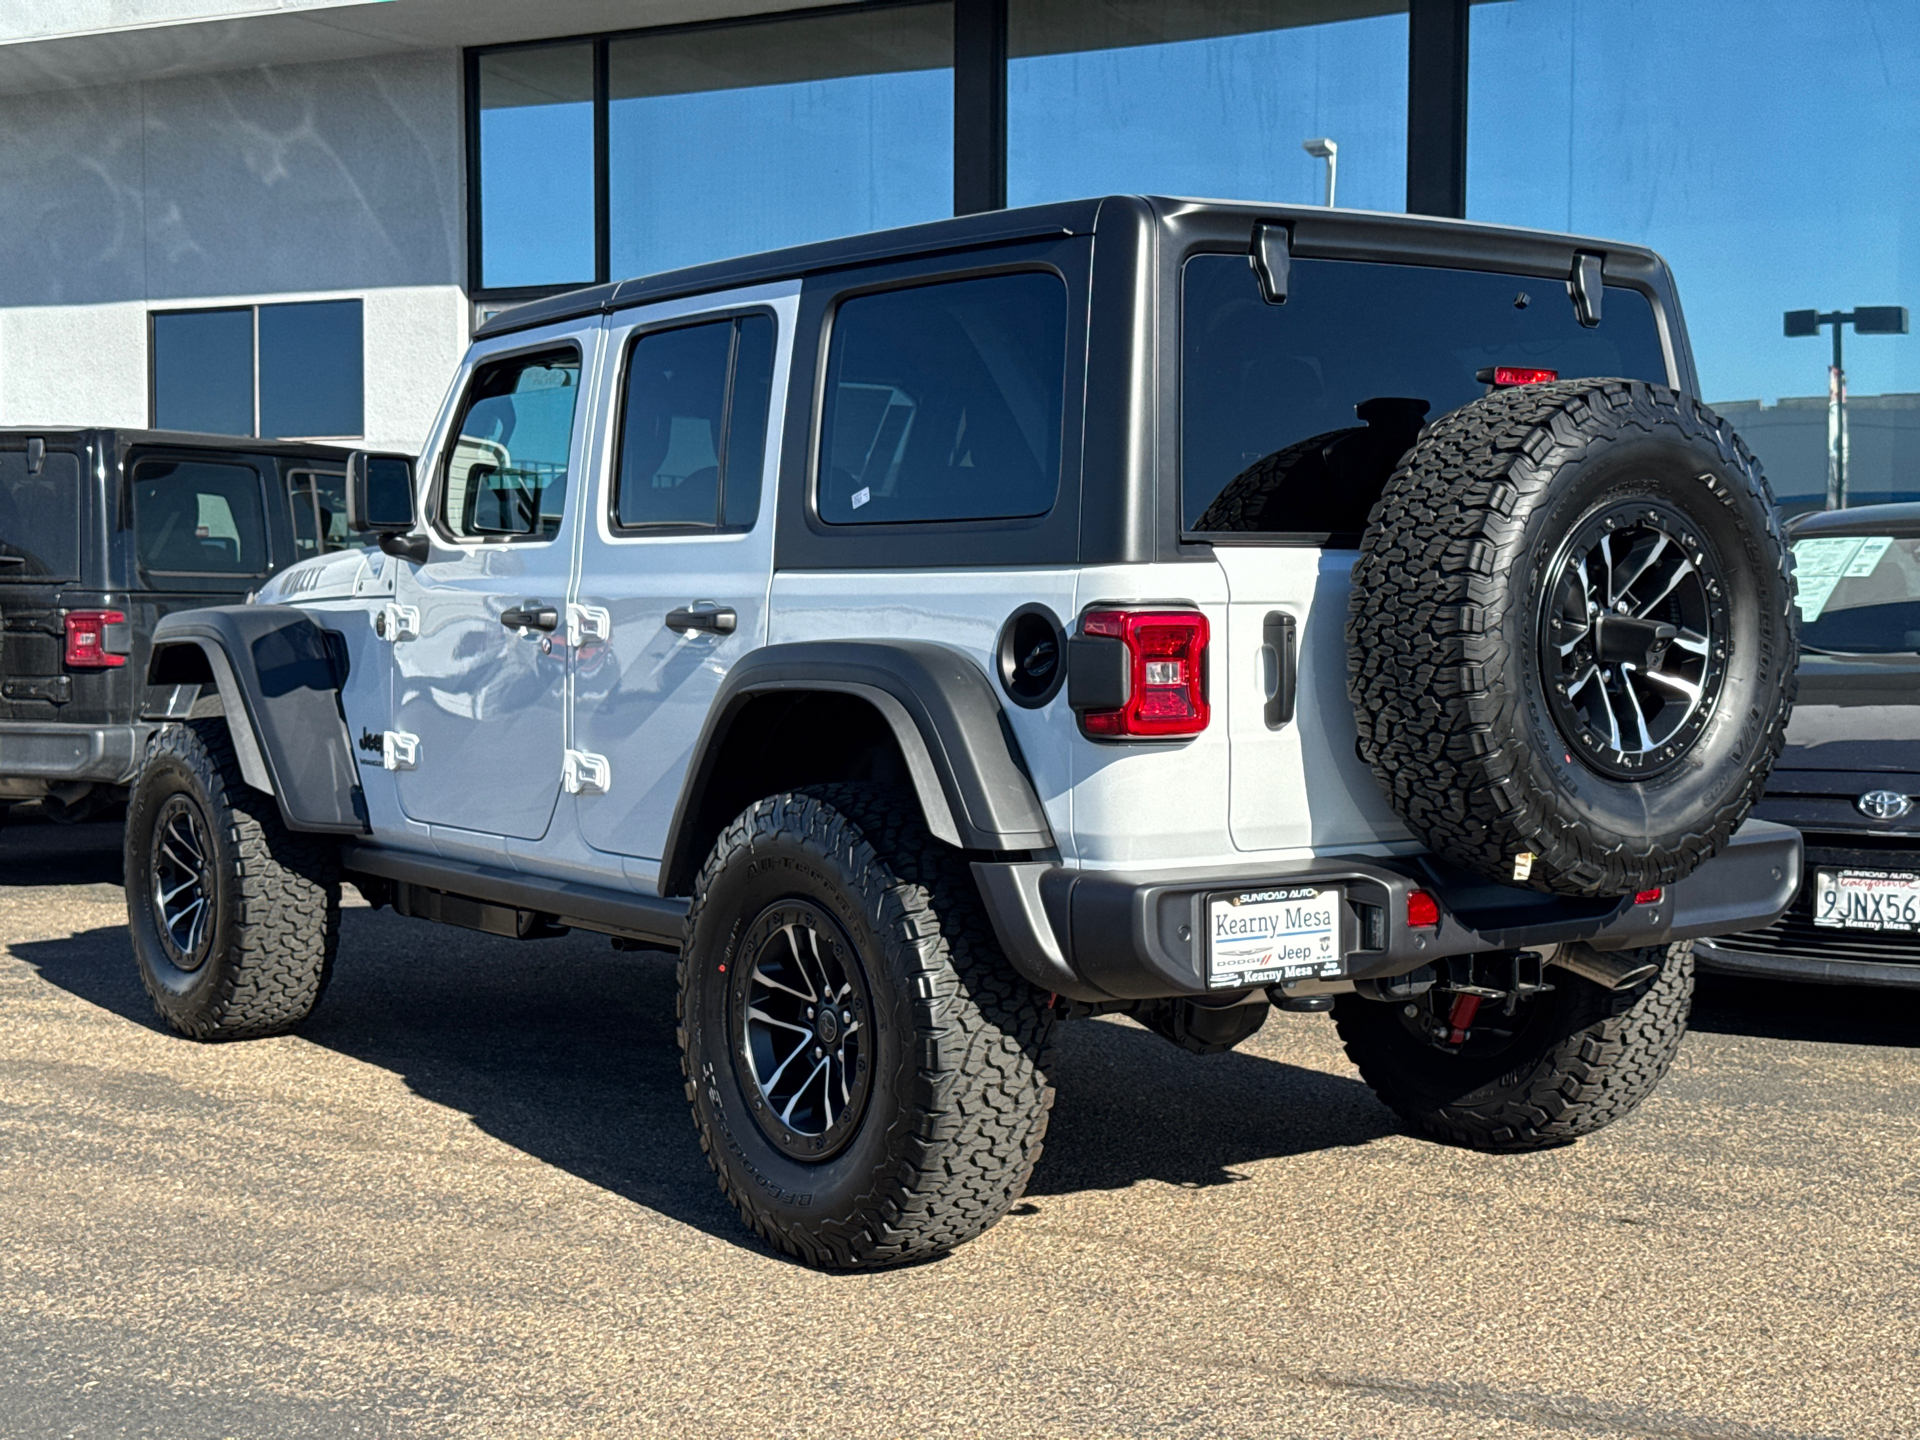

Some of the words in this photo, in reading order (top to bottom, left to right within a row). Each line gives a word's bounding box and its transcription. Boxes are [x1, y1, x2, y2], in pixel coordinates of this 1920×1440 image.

[1843, 870, 1888, 879] SUNROAD
[1889, 872, 1914, 880] AUTO
[1240, 890, 1287, 902] SUNROAD
[1288, 888, 1315, 898] AUTO
[1823, 890, 1920, 922] 9JNX56
[1215, 914, 1279, 939] Kearny
[1285, 907, 1331, 929] Mesa
[1845, 918, 1882, 931] Kearny
[1883, 920, 1912, 930] Mesa
[1278, 945, 1312, 961] Jeep
[1244, 968, 1283, 983] Kearny
[1284, 965, 1312, 979] Mesa
